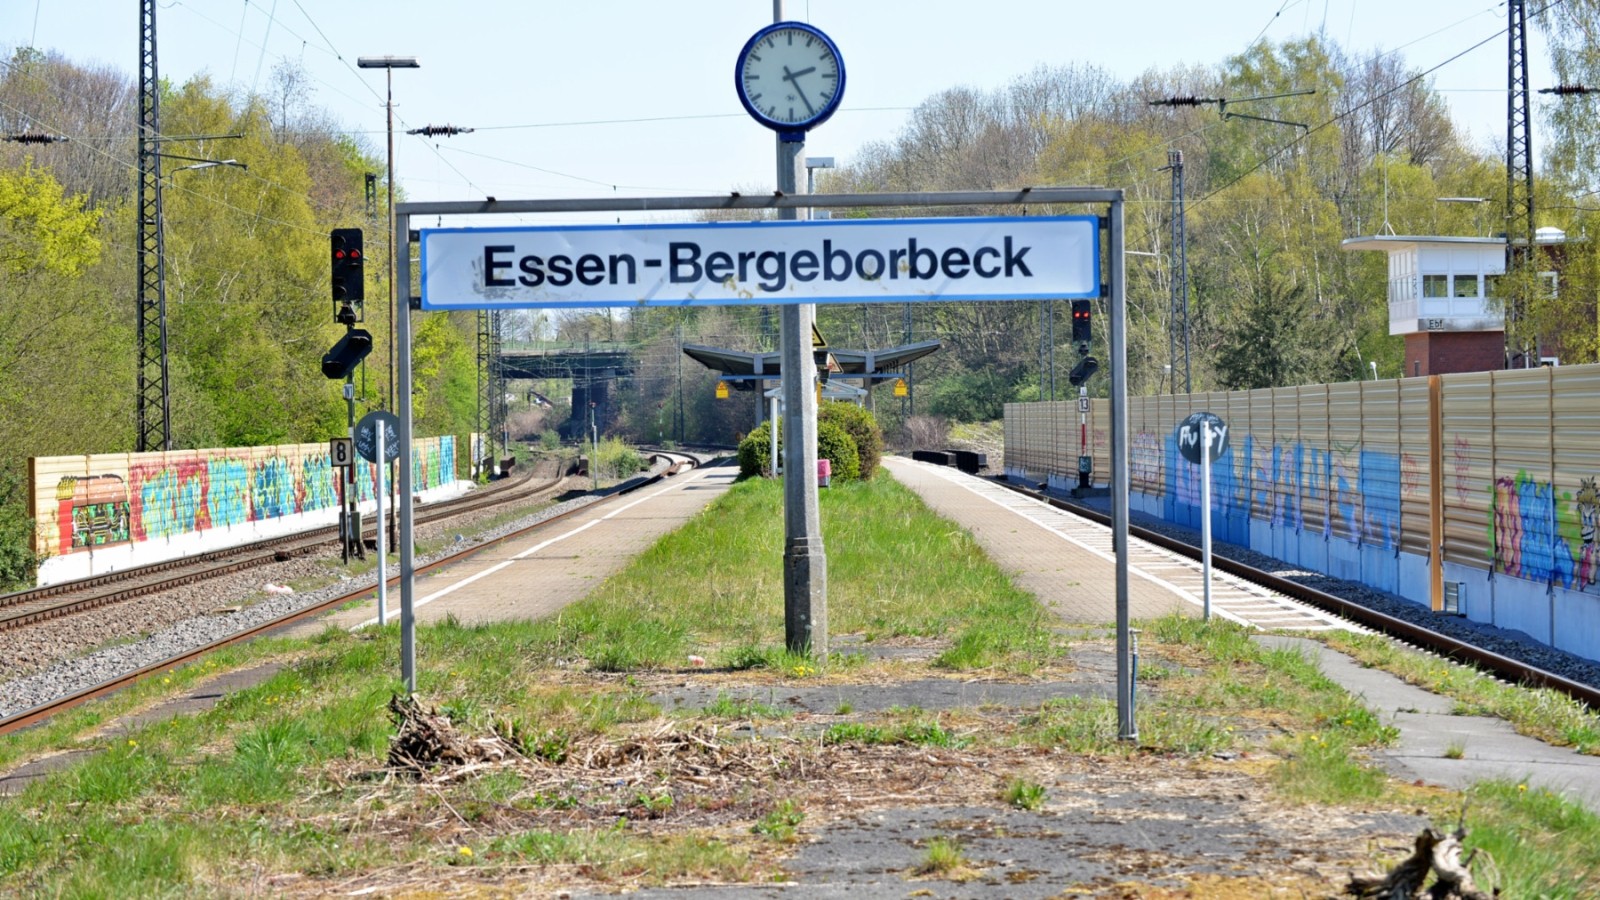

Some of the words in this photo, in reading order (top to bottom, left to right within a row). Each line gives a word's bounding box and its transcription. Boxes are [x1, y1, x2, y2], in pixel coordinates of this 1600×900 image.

[484, 235, 1034, 291] Essen-Bergeborbeck
[1080, 399, 1089, 410] 13
[336, 442, 346, 462] 8
